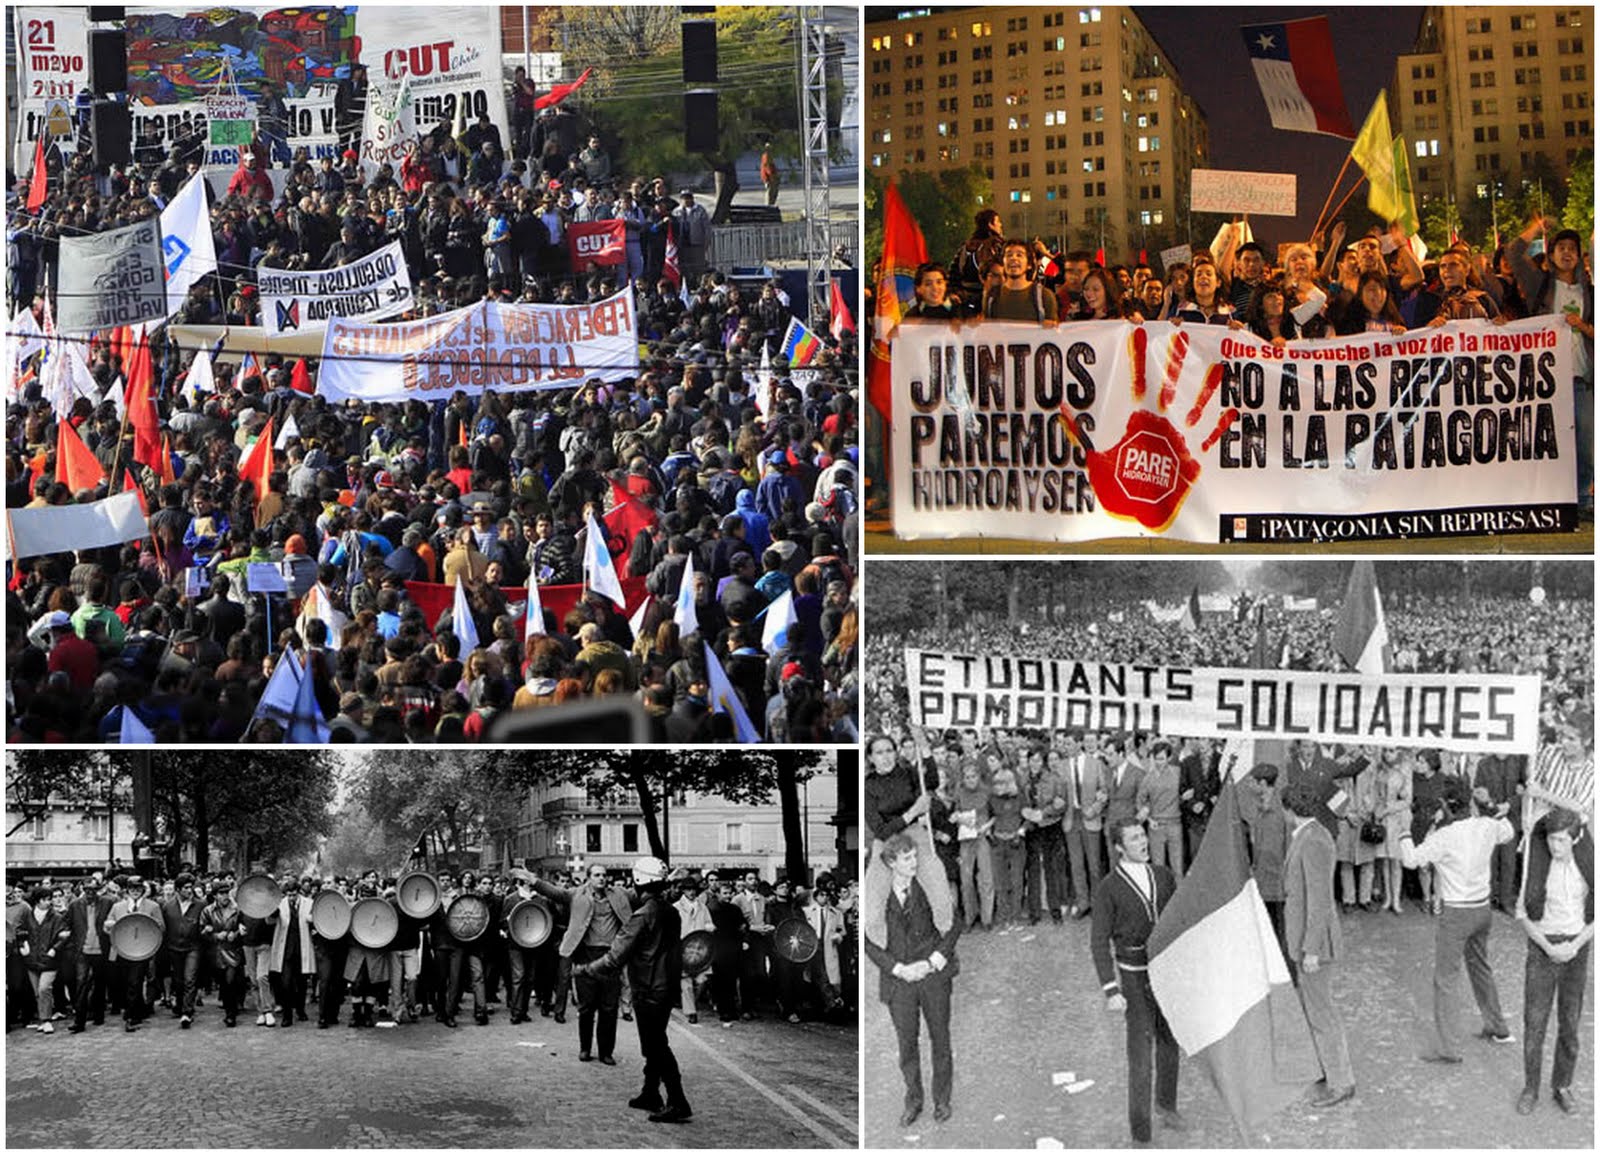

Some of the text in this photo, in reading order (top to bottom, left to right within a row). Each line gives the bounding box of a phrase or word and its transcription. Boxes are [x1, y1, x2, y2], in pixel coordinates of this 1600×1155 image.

[28, 20, 55, 45] 21
[32, 54, 83, 73] mayo
[384, 41, 454, 79] CUT
[576, 234, 612, 252] CUT
[1220, 327, 1557, 361] Que se escuche la voz de la mayoría
[910, 341, 1097, 412] JUNTOS
[1220, 351, 1557, 411] NO A LAS REPRESAS
[910, 411, 1097, 469] PAREMOS
[1220, 403, 1559, 471] EN LA PATAGONIA
[1124, 447, 1173, 478] PARE
[911, 469, 1096, 514] HIDROAYSEN
[1399, 513, 1434, 536] SIN
[1440, 508, 1562, 534] REPRESAS!
[920, 652, 1515, 741] ETUDIANTS SOLIDAIRES
